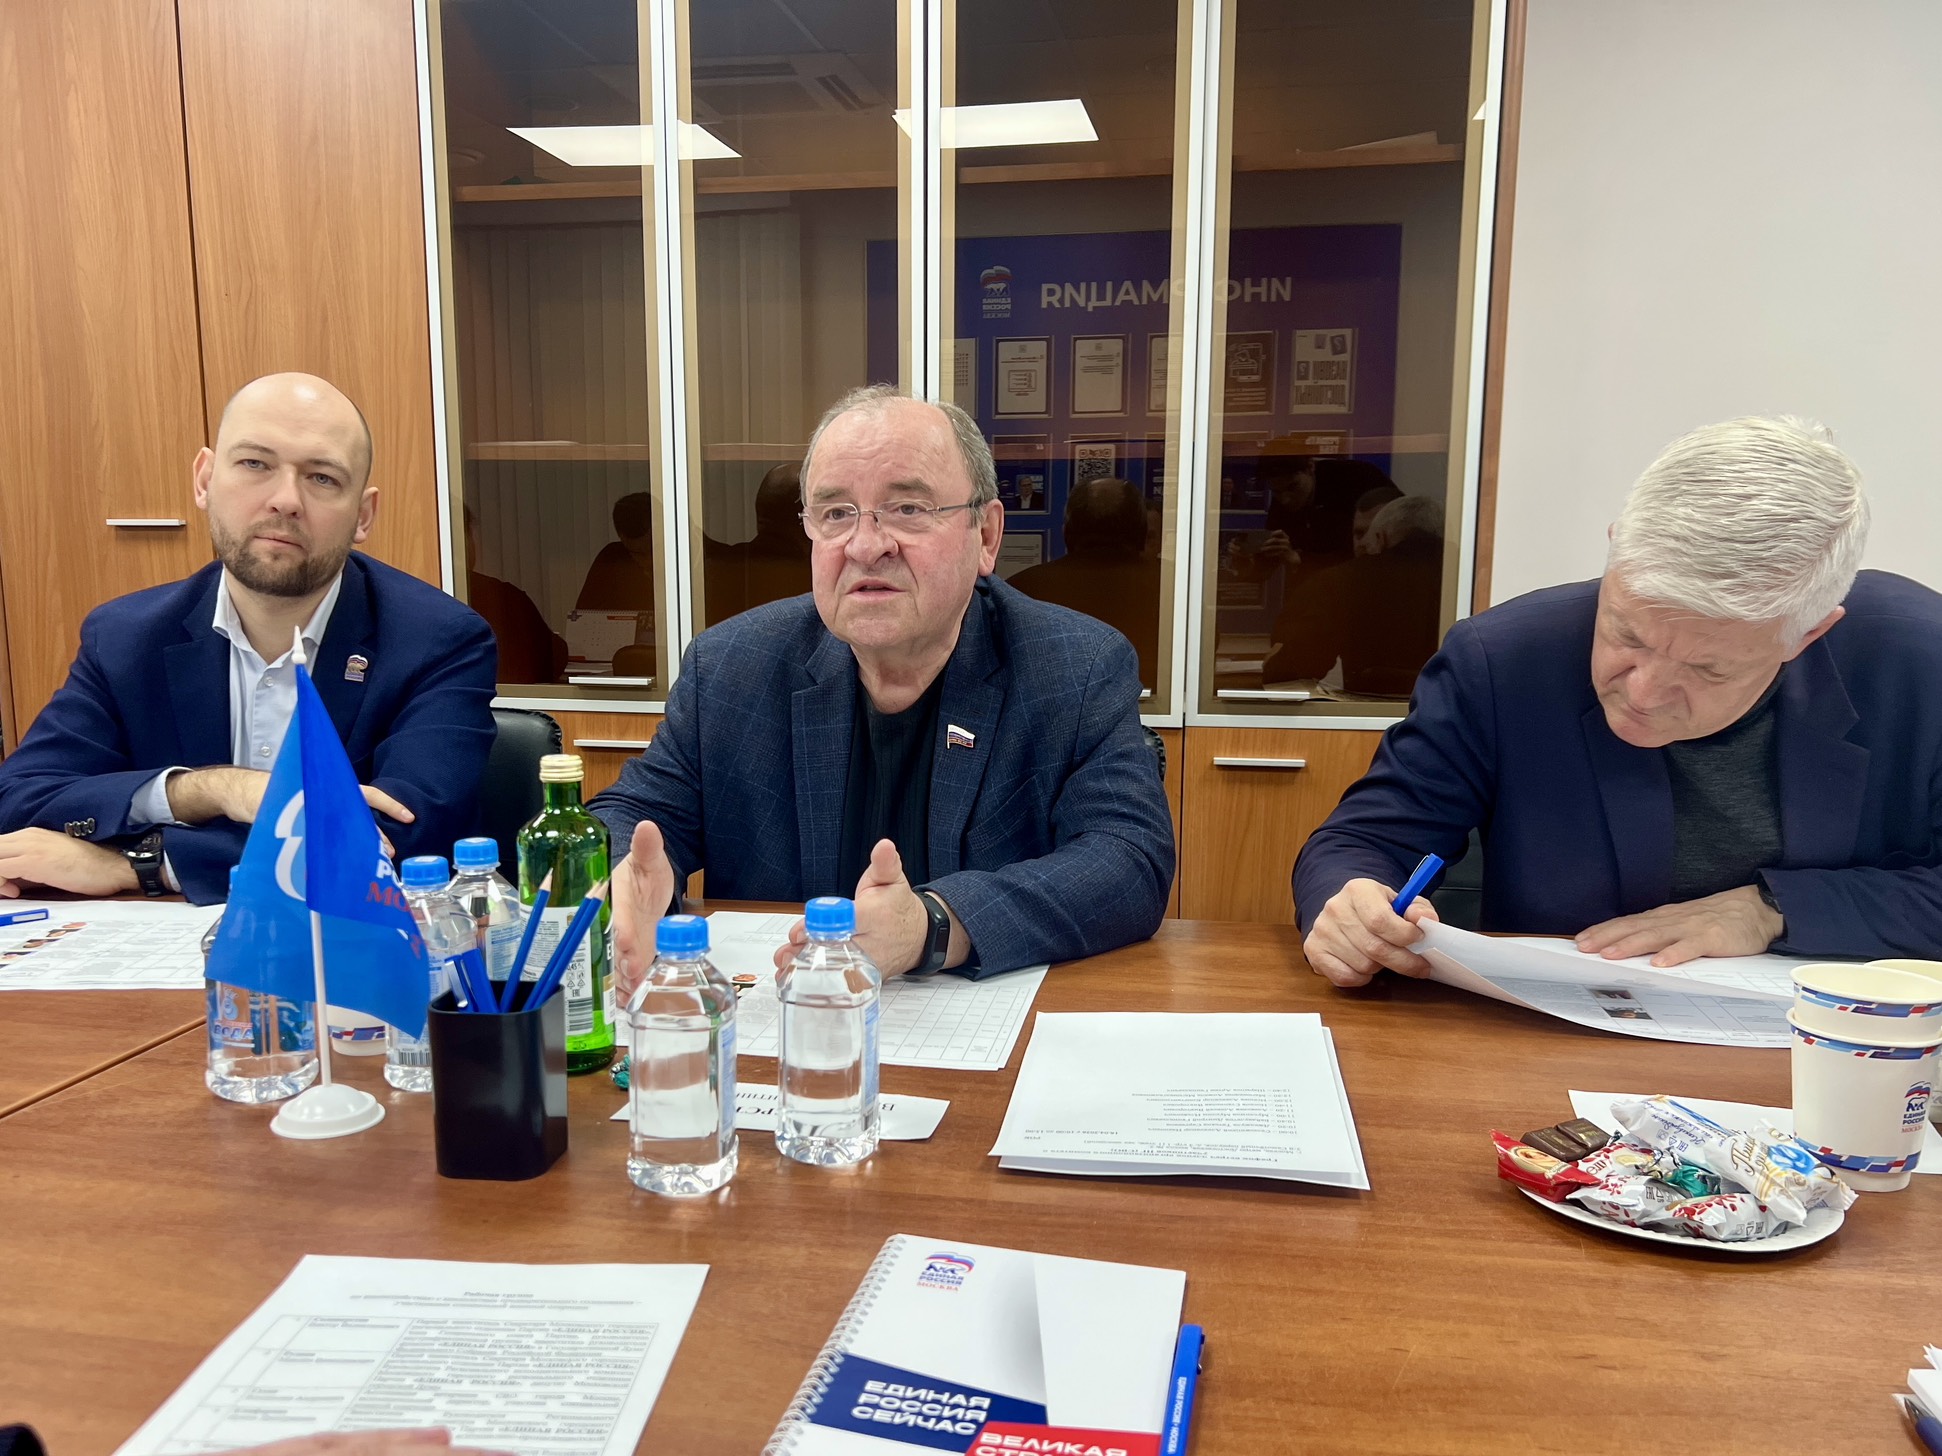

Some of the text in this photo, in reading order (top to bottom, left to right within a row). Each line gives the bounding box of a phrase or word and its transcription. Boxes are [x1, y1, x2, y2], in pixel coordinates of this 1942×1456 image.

[858, 1392, 987, 1422] РОССИЯ
[865, 1380, 991, 1409] ЕДИНАЯ
[851, 1406, 977, 1435] СЕЙЧАС
[980, 1432, 1127, 1456] ВЕЛИКАЯ
